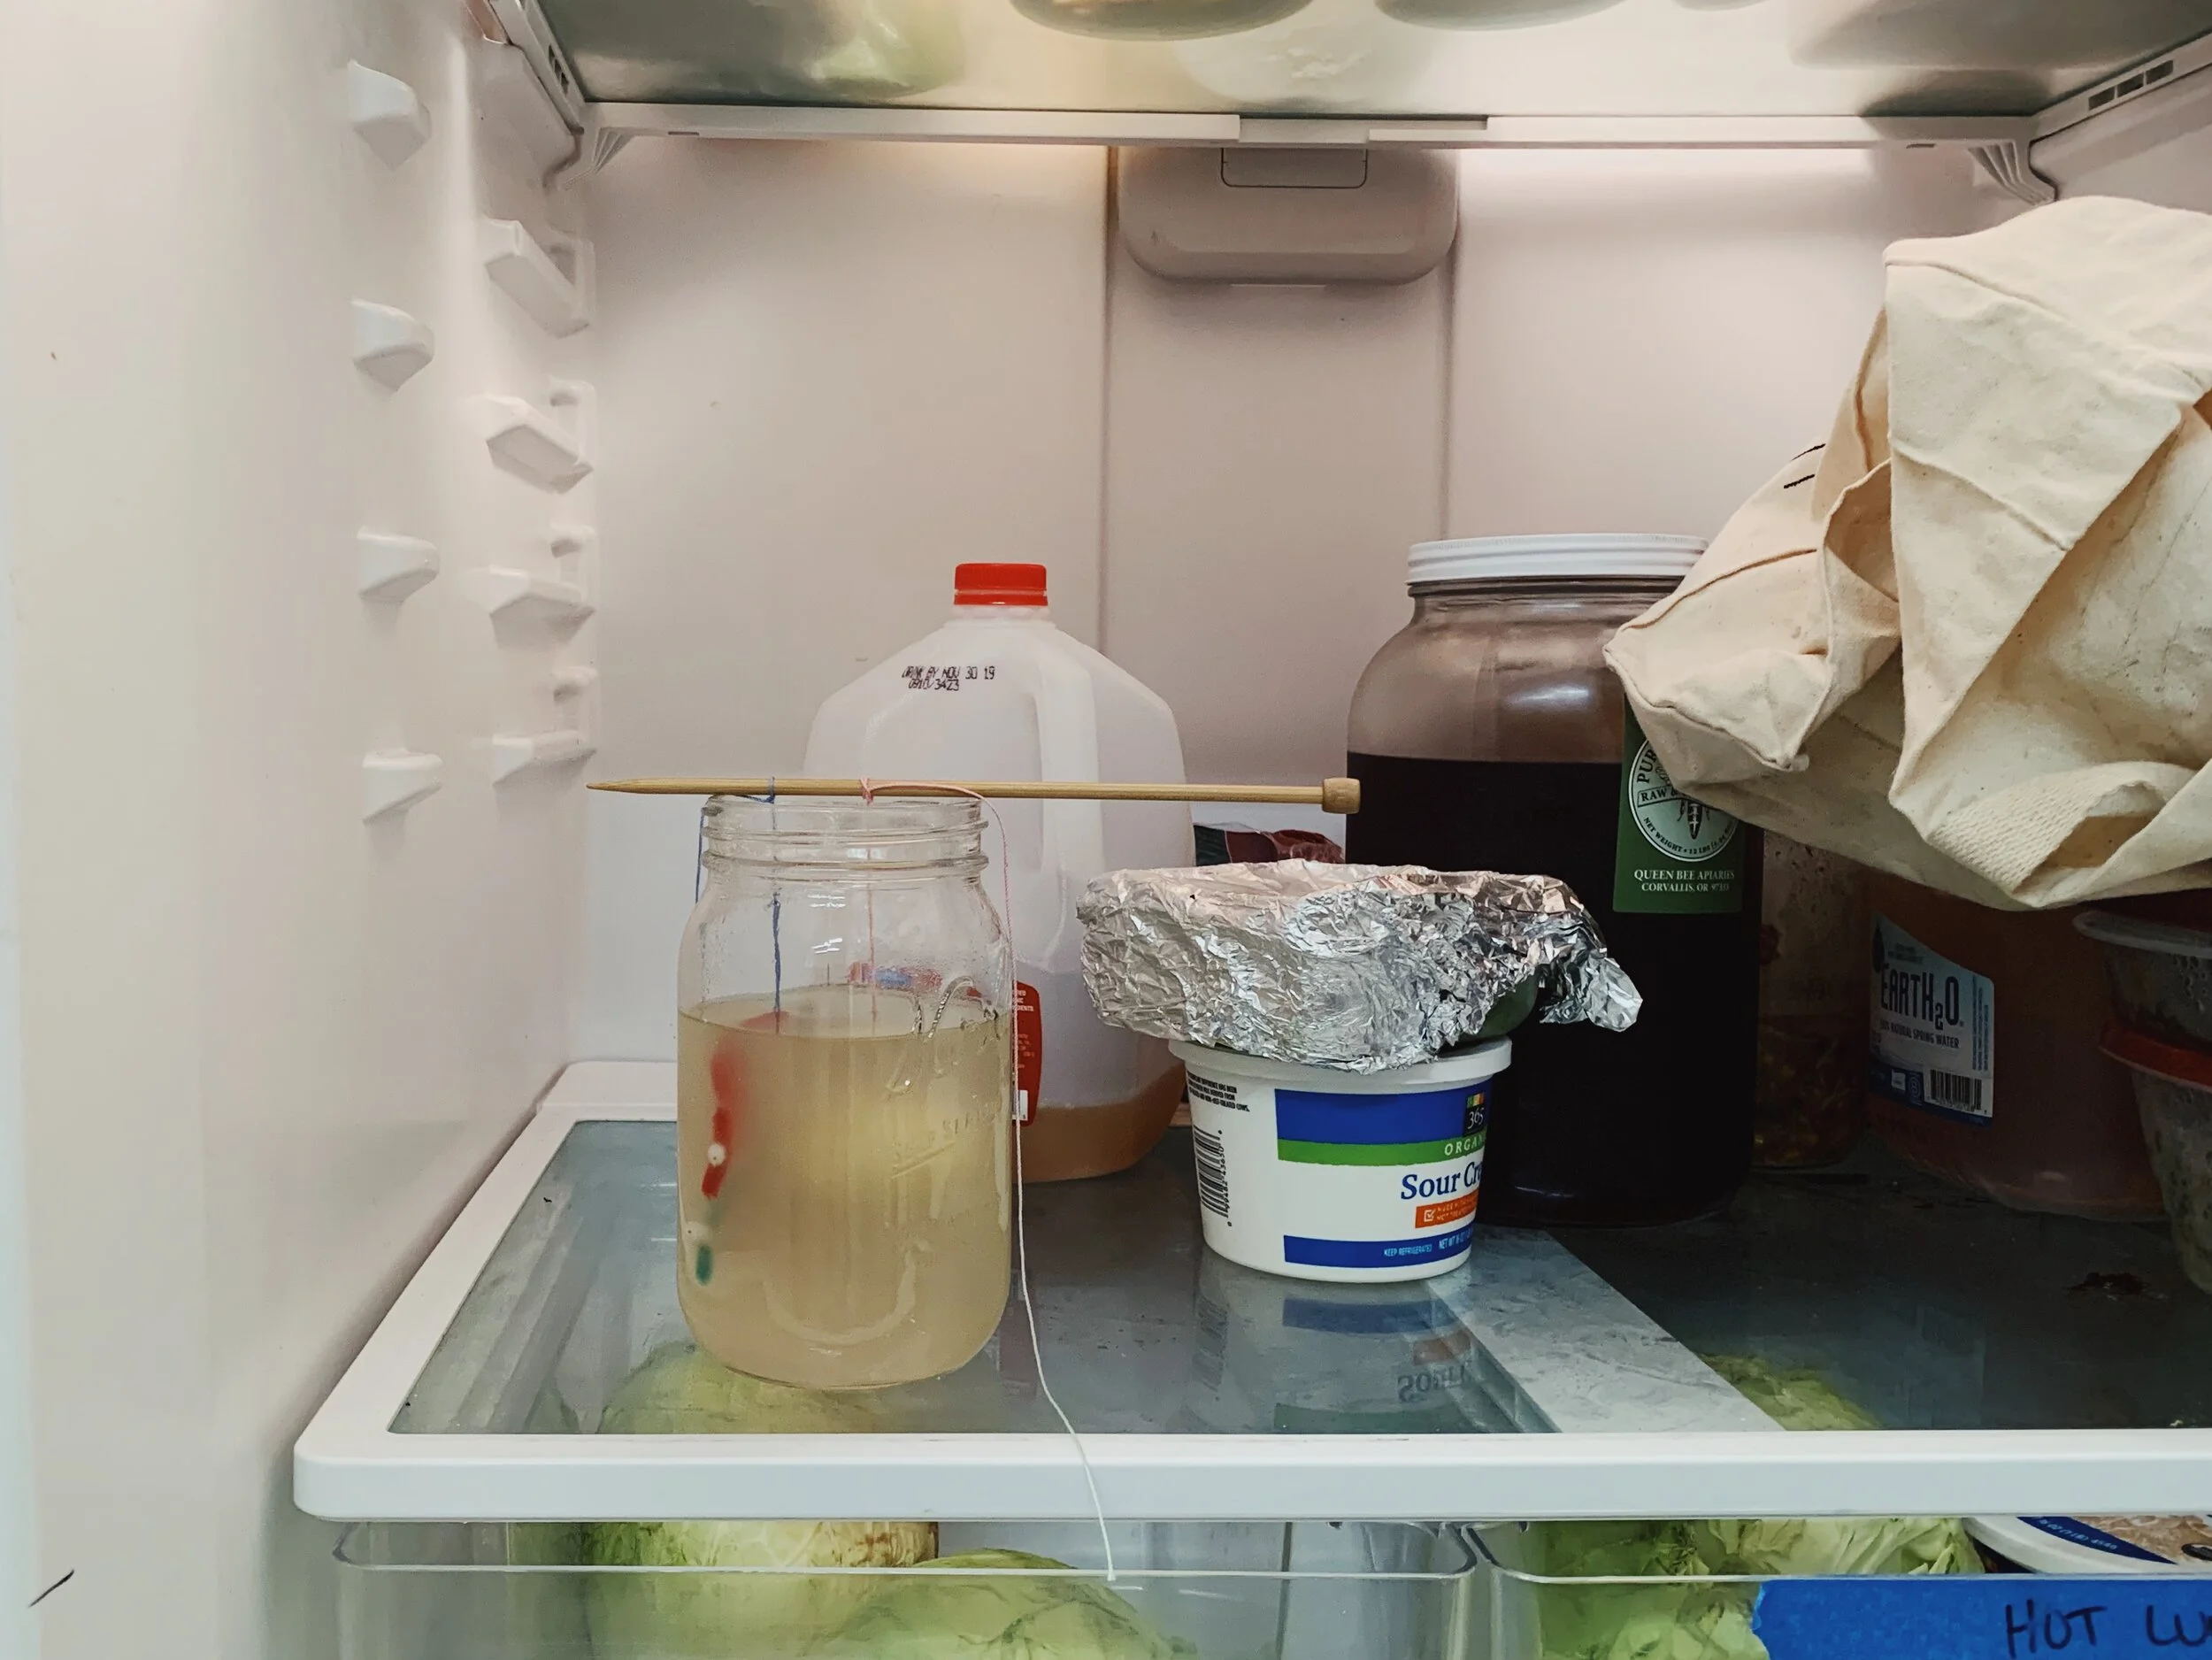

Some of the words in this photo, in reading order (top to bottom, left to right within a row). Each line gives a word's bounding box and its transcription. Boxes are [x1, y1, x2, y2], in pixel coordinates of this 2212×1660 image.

[941, 665, 961, 679] NOV
[965, 665, 979, 680] 30
[984, 665, 995, 680] 19
[1641, 788, 1668, 802] RAW
[1644, 817, 1656, 832] NET
[1655, 832, 1683, 852] WEIGHT
[1634, 869, 1674, 881] QUEEN
[1676, 870, 1695, 880] BEE
[1697, 871, 1735, 880] APIARIES
[1696, 882, 1709, 892] OR
[1935, 1034, 1959, 1049] WATER
[1467, 1107, 1485, 1129] 365
[1401, 1172, 1462, 1200] Sour
[2005, 1599, 2108, 1660] HOT
[2145, 1604, 2212, 1648] LU
